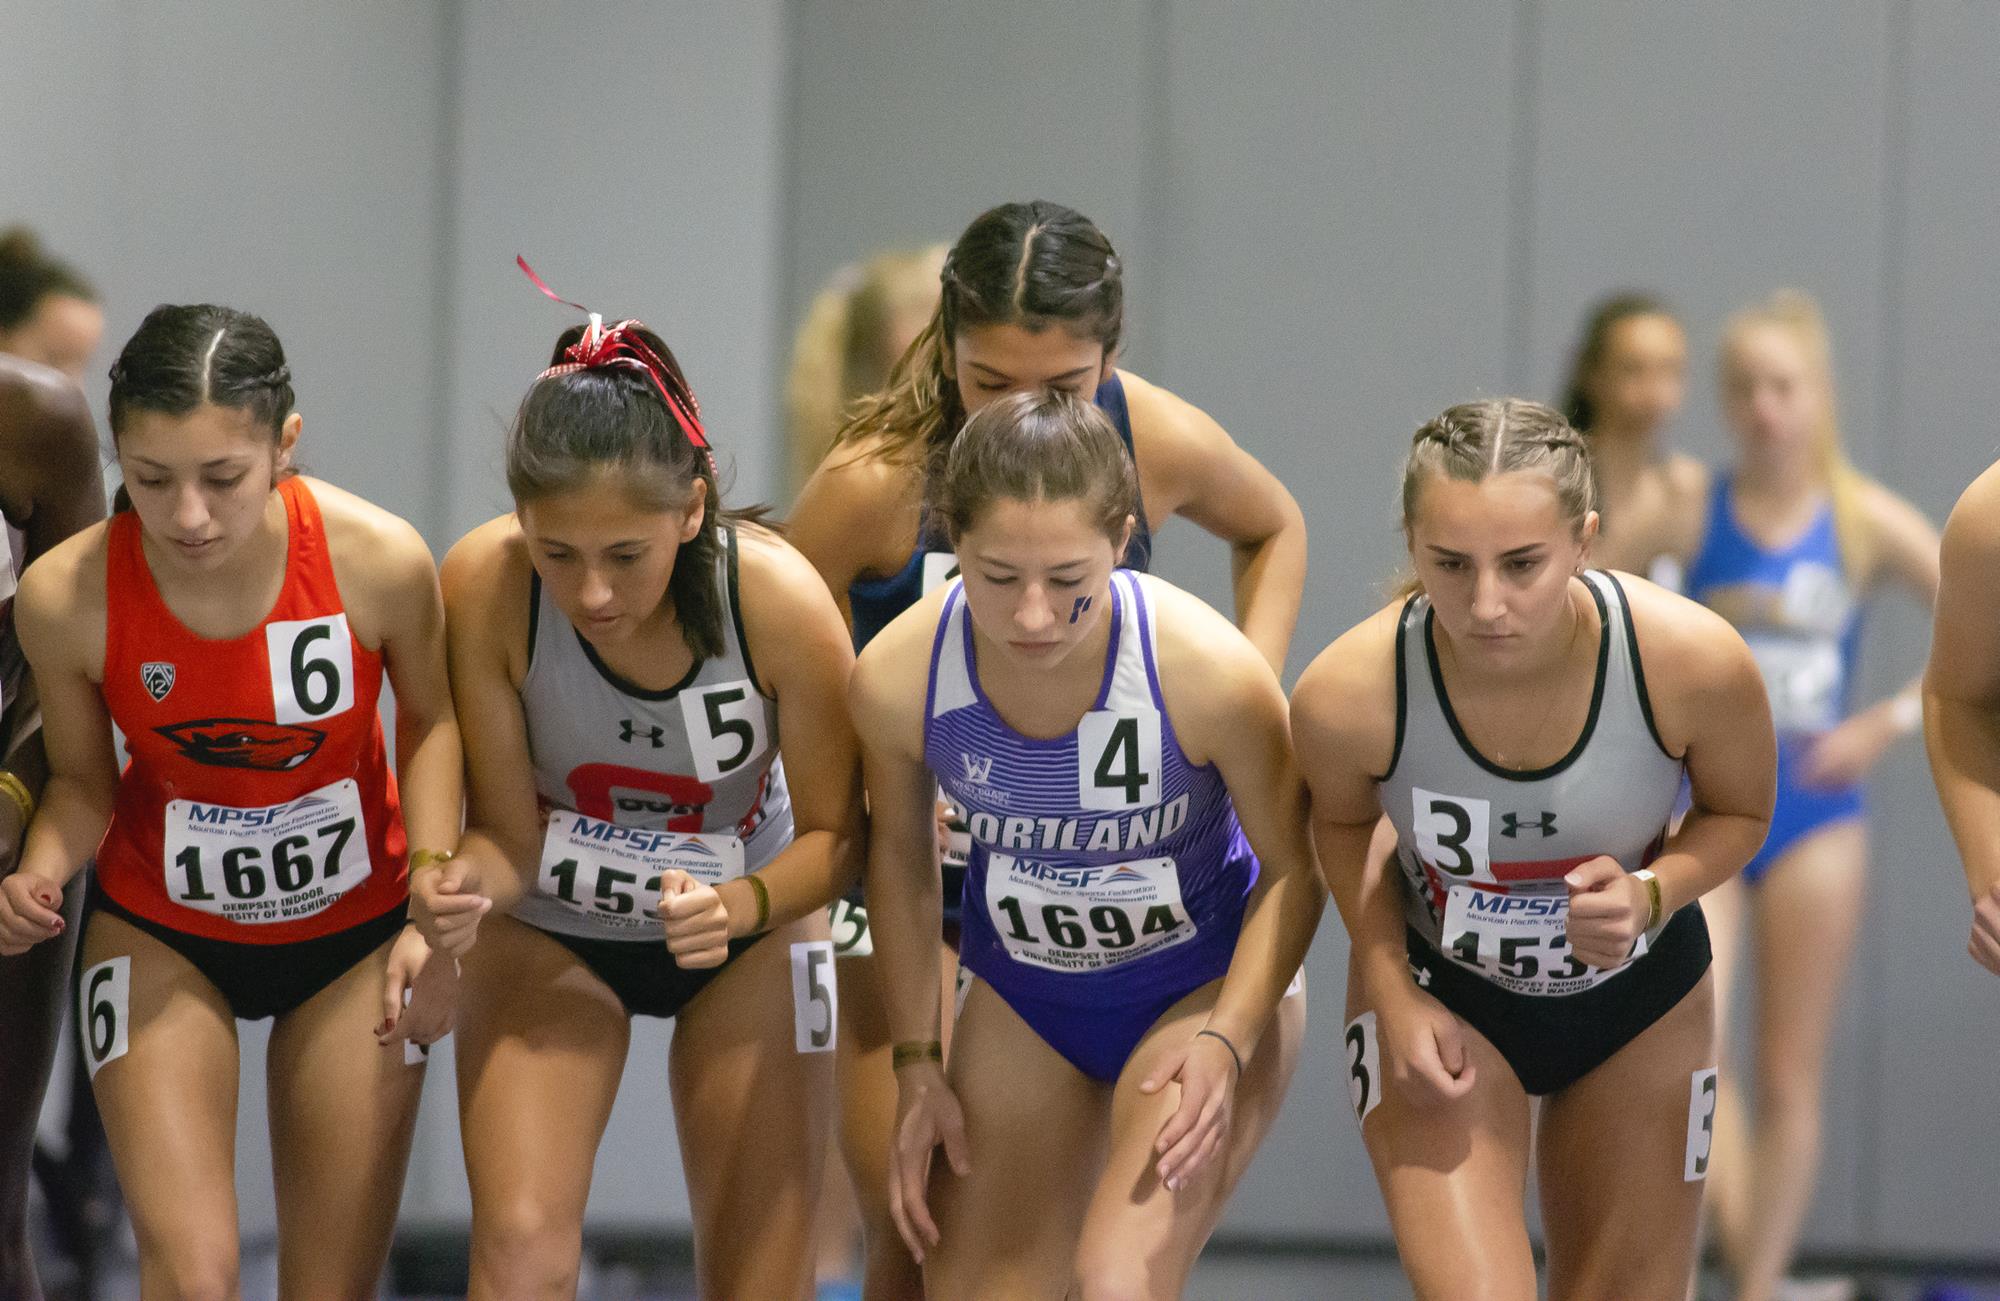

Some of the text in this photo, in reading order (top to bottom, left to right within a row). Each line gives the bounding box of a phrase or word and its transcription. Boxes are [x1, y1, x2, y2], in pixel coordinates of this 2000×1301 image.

[150, 679, 167, 693] 12
[290, 624, 341, 716] 6
[702, 687, 755, 773] 5
[1093, 717, 1149, 804] 4
[188, 804, 288, 828] MPSF
[571, 816, 676, 852] MPSF
[1429, 800, 1475, 876] 3
[176, 816, 356, 901] 1667
[673, 858, 723, 868] Federation
[1010, 857, 1104, 888] MPSF
[222, 886, 324, 912] DEMPSEY INDOOR
[263, 909, 278, 919] OF
[1466, 912, 1509, 926] Mountain
[997, 895, 1186, 949] 1694
[1087, 960, 1101, 969] OF
[87, 966, 115, 1062] 6
[807, 949, 832, 1047] 5
[1346, 1023, 1371, 1122] 3
